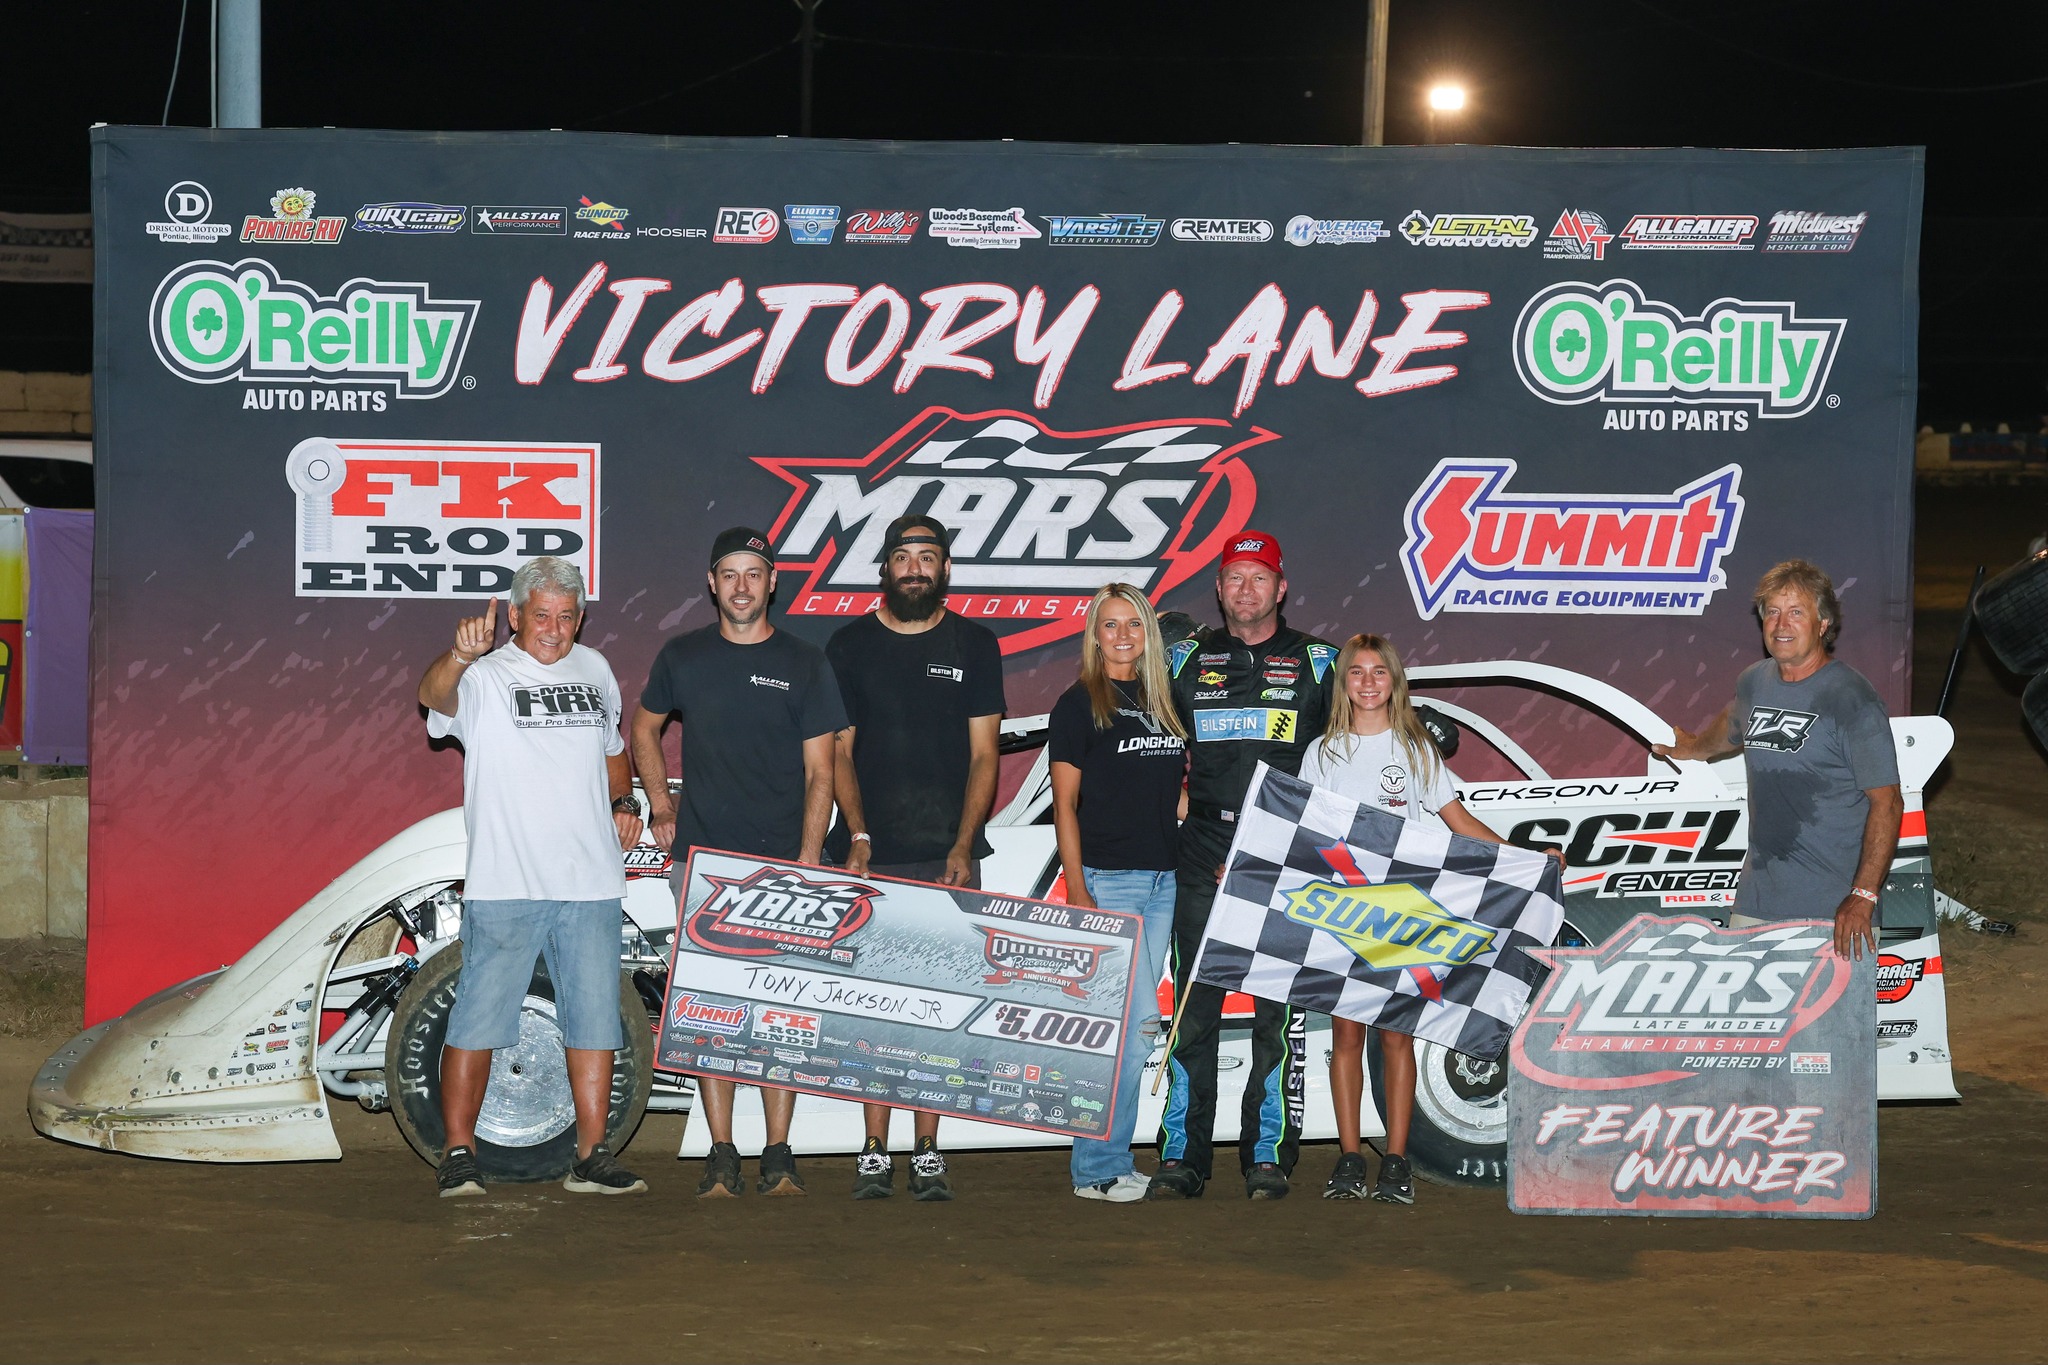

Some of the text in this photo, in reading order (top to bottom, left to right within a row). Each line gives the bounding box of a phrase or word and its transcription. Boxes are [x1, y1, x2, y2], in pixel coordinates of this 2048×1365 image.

[176, 193, 205, 216] D
[576, 208, 629, 220] SUNOCO
[791, 207, 835, 216] ELLIOTT'S
[491, 211, 561, 221] ALLSTAR
[846, 211, 919, 235] Willy's
[932, 211, 1018, 223] Woods Basement
[1317, 220, 1383, 231] WEHRS
[1768, 211, 1867, 234] Midwest
[149, 224, 229, 234] DRISCOLL MOTORS
[162, 232, 216, 241] Pontiac, Illinois
[243, 217, 342, 240] PONTIAC RV
[573, 231, 631, 240] RACE FUELS
[636, 227, 708, 239] HOOSIER
[976, 221, 1015, 234] Systems
[1181, 220, 1262, 239] REMTEK
[1430, 217, 1533, 237] LETHAL
[1626, 218, 1755, 239] ALLGAIER
[961, 236, 979, 245] Family
[979, 237, 1000, 245] Serving
[1053, 237, 1149, 245] SCREENPRINTING
[1427, 237, 1528, 245] CHASSIS
[1768, 234, 1808, 242] SHEET
[169, 276, 455, 380] O'Reilly
[514, 261, 1490, 418] VICTORY LANE
[1532, 297, 1820, 399] O'Reilly
[242, 389, 387, 412] AUTO PARTS
[1603, 409, 1749, 432] AUTO PARTS
[331, 459, 582, 520] FK
[778, 473, 1198, 588] MARS
[366, 525, 584, 556] ROD
[302, 562, 516, 593] END
[1453, 588, 1705, 609] RACING EQUIPMENT
[1198, 674, 1227, 682] SUNOCO
[516, 719, 542, 728] Super
[1200, 716, 1258, 732] BILSTEIN
[1139, 749, 1182, 757] CHASSIS
[1750, 740, 1772, 748] JACKSON
[1456, 781, 1679, 802] ACKSON JR
[708, 883, 853, 929] MARS
[1665, 894, 1706, 903] ROB
[981, 899, 1125, 934] JULY 20th, 2025
[1294, 887, 1488, 964] SUNOCO
[713, 924, 830, 948] CHAMPIONSHIP
[753, 920, 832, 937] LATE MODEL
[774, 943, 831, 957] POWERED BY
[991, 937, 1091, 971] QUINCY
[1012, 955, 1068, 976] Raceways
[1876, 961, 1923, 980] RAGE
[1022, 972, 1072, 987] ANNIVERSARY
[743, 966, 811, 1002] TONY
[813, 981, 908, 1014] JACKSON
[1543, 960, 1813, 1020] MARS
[680, 1021, 739, 1034] RACING EQUIPMENT
[761, 1010, 817, 1031] FK
[995, 1004, 1115, 1049] $5,000
[1633, 1020, 1779, 1031] LATE MODEL
[752, 1030, 814, 1047] ENDS
[768, 1024, 816, 1038] ROD
[1560, 1038, 1781, 1052] CHAMPIONSHIP
[1286, 1012, 1306, 1129] BILSTEIN
[1681, 1056, 1788, 1069] POWERED BY
[1033, 1089, 1064, 1098] ALLSTAR
[1536, 1103, 1824, 1151] FEATURE
[1615, 1144, 1846, 1194] WINNER
